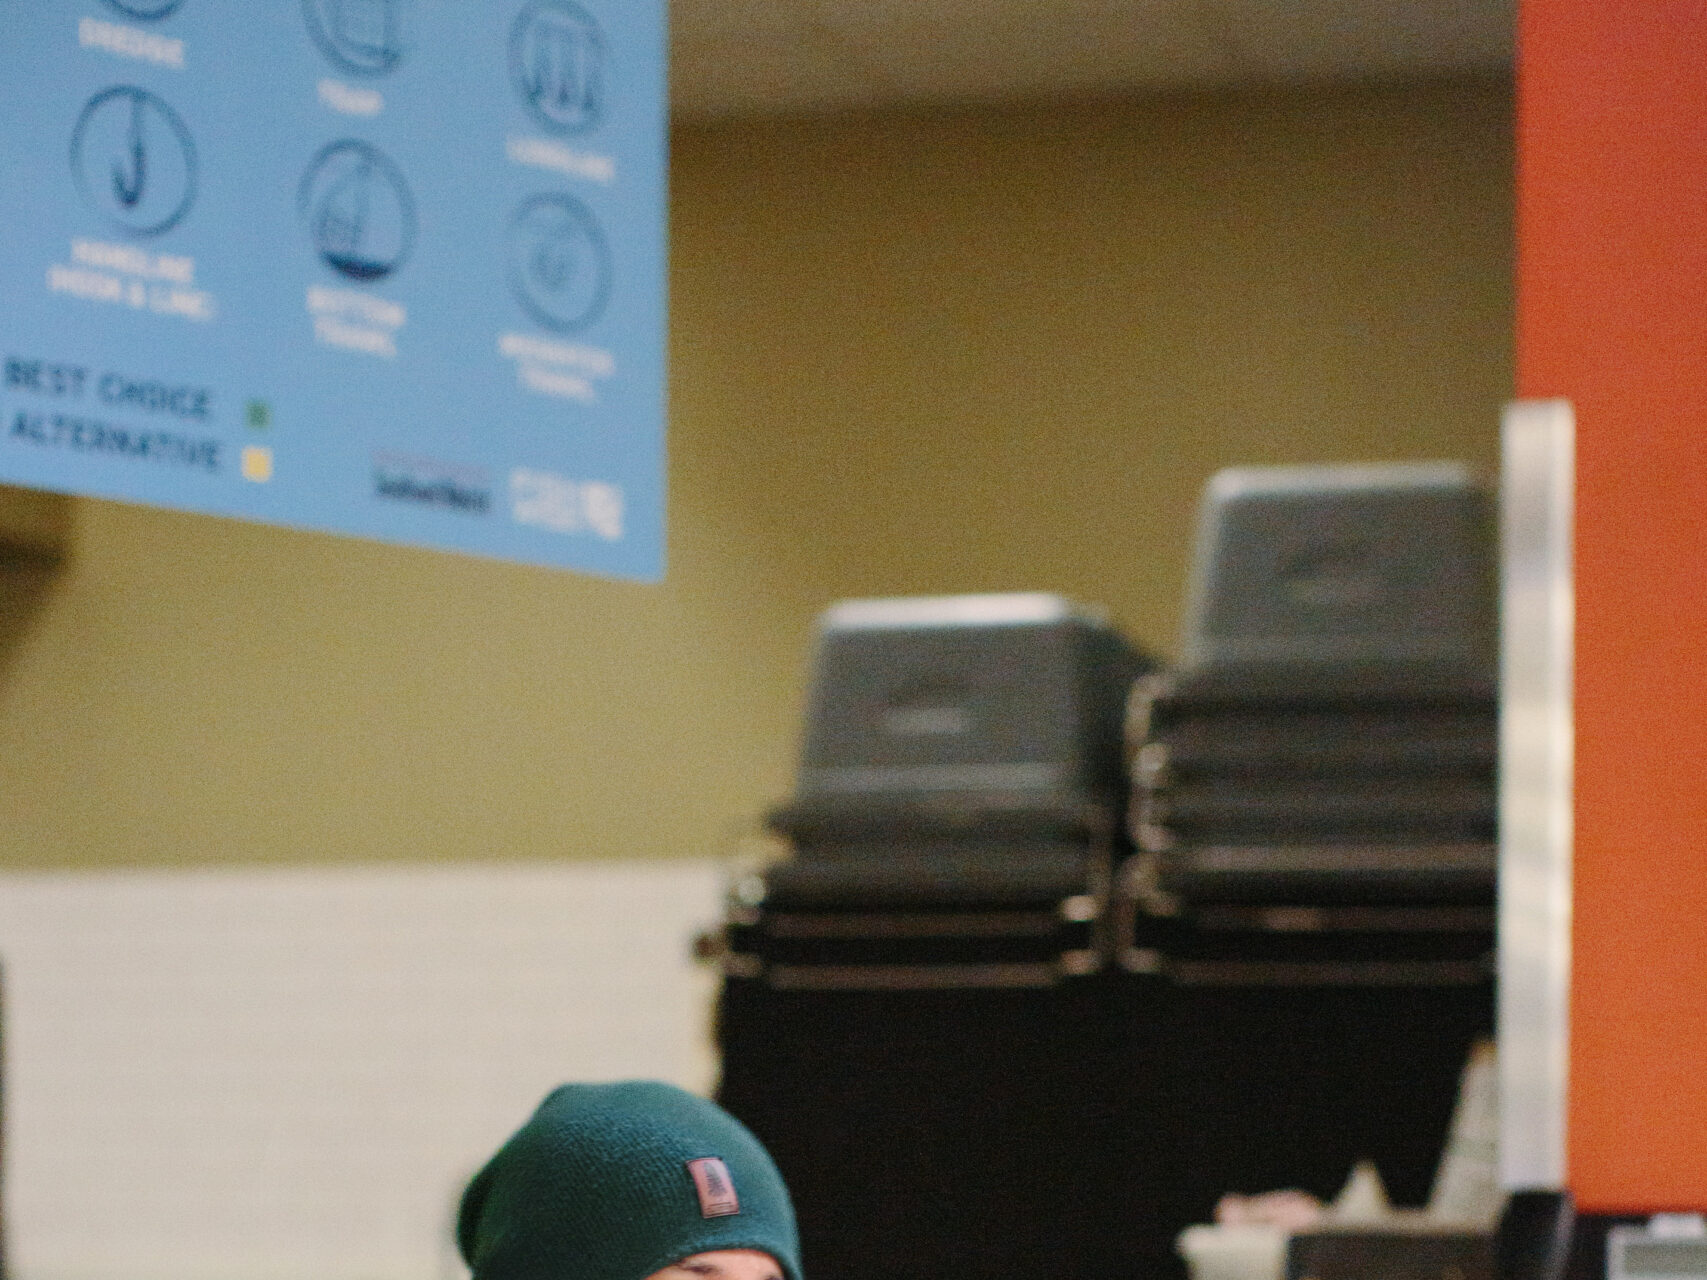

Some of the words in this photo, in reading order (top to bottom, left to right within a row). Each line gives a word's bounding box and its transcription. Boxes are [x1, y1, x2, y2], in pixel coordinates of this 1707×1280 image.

[4, 356, 84, 394] BEST
[98, 373, 209, 419] CHOICE
[10, 408, 218, 470] ALTERNATIVE
